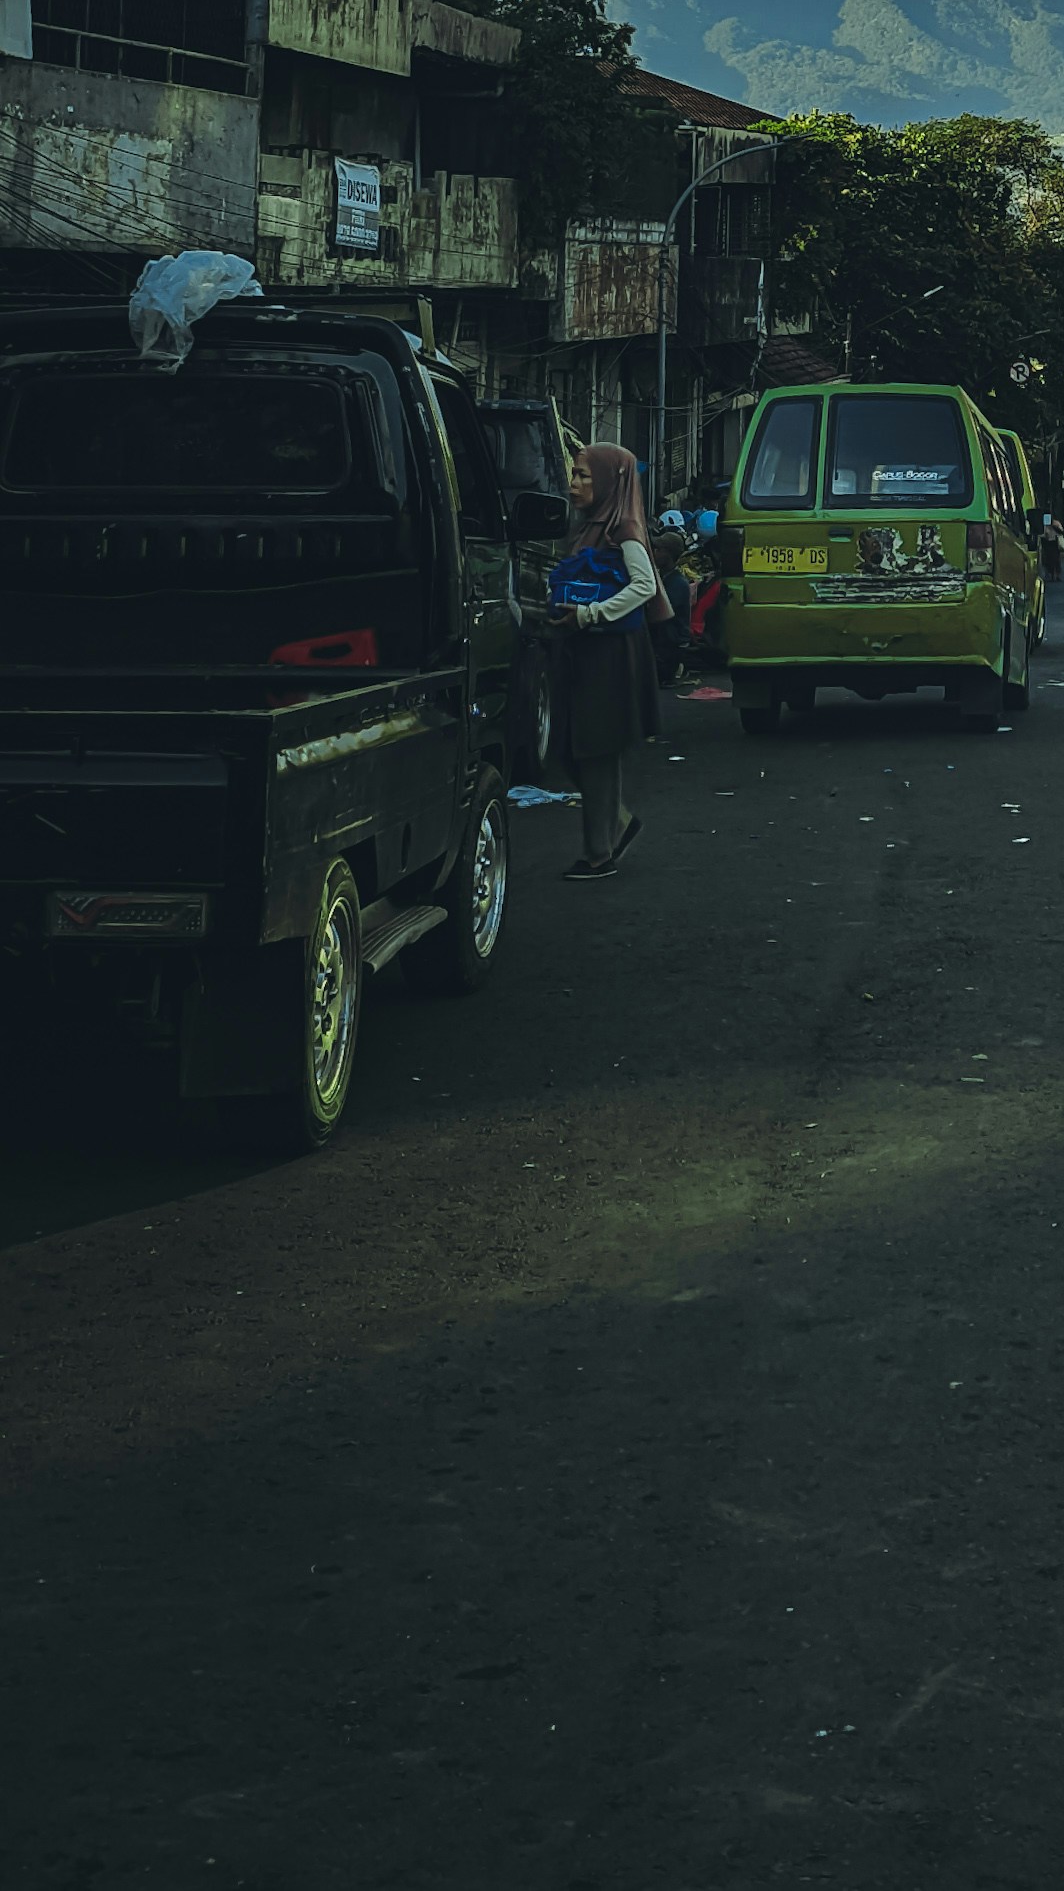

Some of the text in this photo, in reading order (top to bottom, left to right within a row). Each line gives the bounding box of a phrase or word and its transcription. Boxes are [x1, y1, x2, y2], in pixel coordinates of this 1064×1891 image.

[347, 178, 378, 206] DISEWA
[745, 548, 826, 564] F 1958 DS
